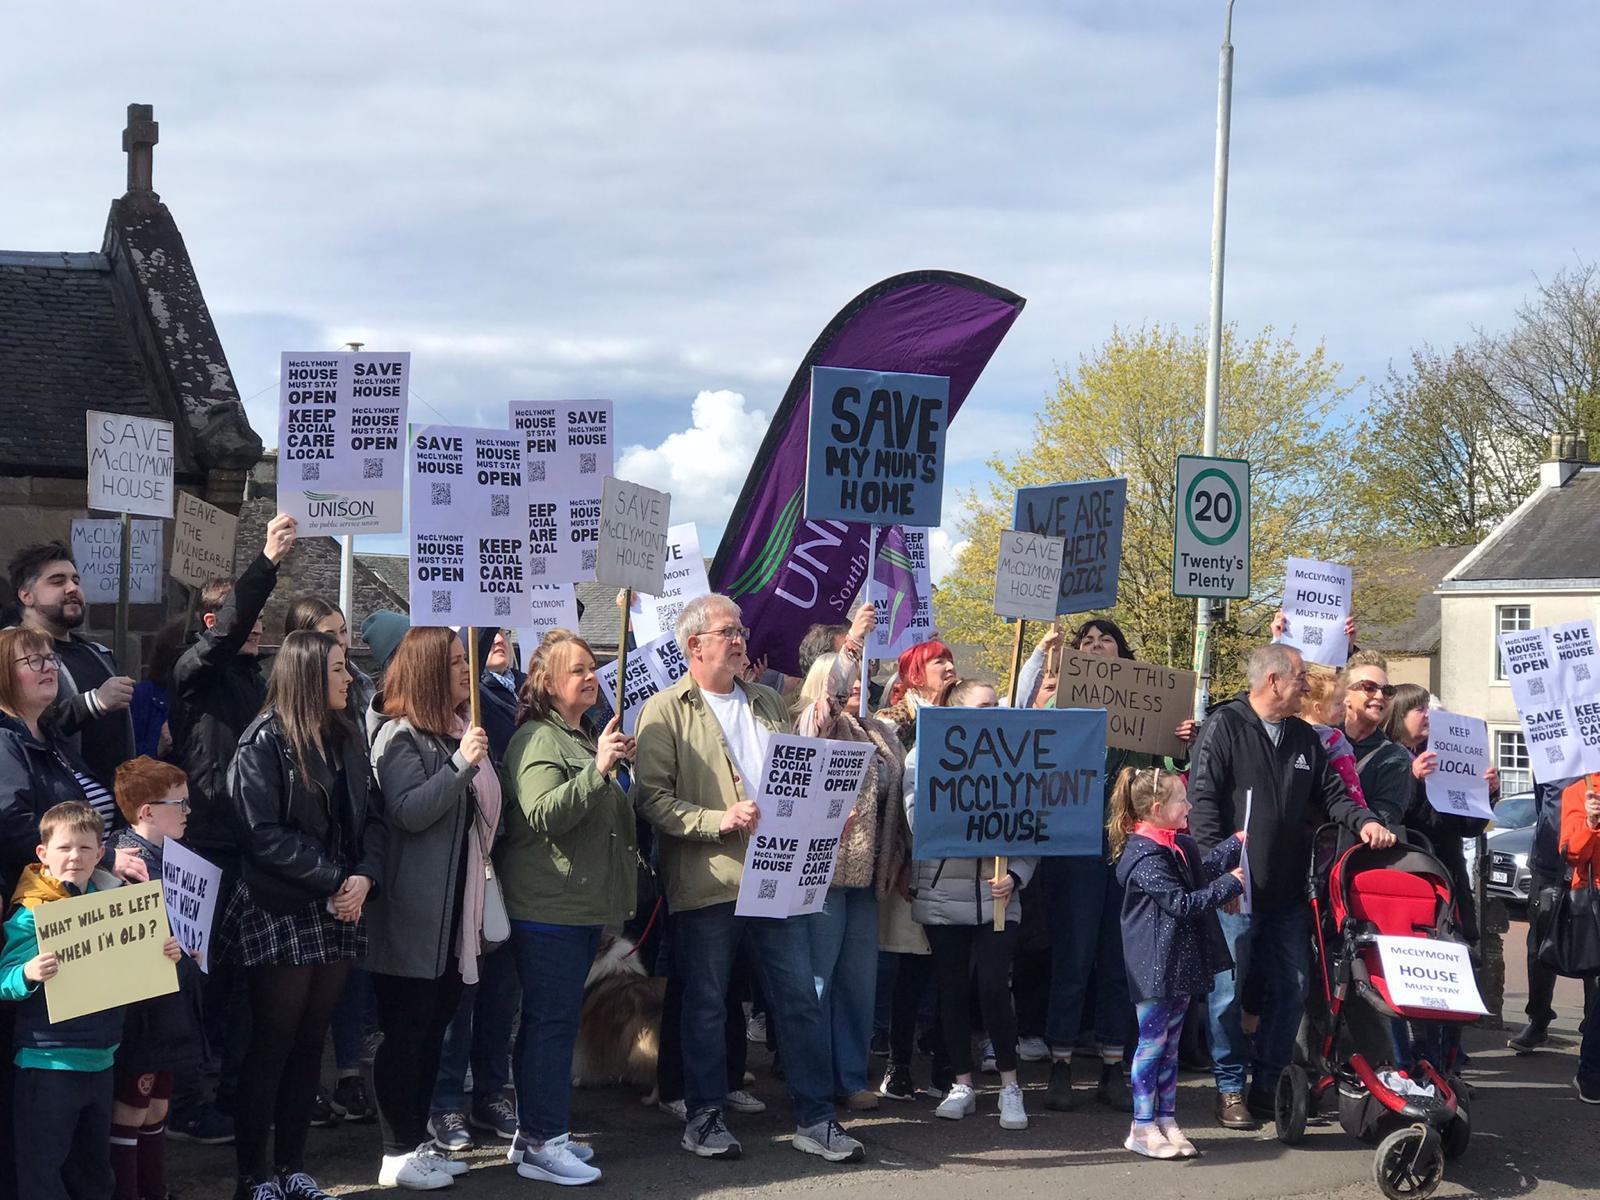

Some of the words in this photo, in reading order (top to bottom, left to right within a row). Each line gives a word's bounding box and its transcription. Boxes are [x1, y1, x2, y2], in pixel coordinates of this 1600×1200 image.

[288, 360, 338, 368] McCLYMONT
[354, 363, 402, 376] SAVE
[289, 369, 338, 380] HOUSE
[288, 381, 312, 389] MUST
[353, 386, 400, 397] HOUSE
[288, 390, 337, 404] OPEN
[288, 409, 336, 423] KEEP
[351, 416, 399, 427] HOUSE
[515, 418, 556, 429] HOUSE
[567, 411, 607, 424] SAVE
[831, 386, 942, 454] SAVE
[99, 420, 173, 452] SAVE
[288, 424, 335, 433] SOCIAL
[287, 434, 335, 448] CARE
[351, 437, 398, 450] OPEN
[416, 436, 463, 452] SAVE
[476, 439, 520, 447] McCLYMONT
[527, 439, 557, 453] PEN
[568, 434, 607, 446] HOUSE
[287, 449, 334, 461] LOCAL
[476, 448, 520, 461] HOUSE
[825, 446, 870, 478] MY
[90, 448, 174, 477] McCLYMONT
[417, 461, 463, 475] HOUSE
[476, 461, 499, 469] MUST
[500, 462, 521, 470] STAY
[477, 471, 521, 487] OPEN
[102, 475, 165, 501] HOUSE
[840, 479, 915, 516] HOME
[183, 496, 217, 525] LEAVE
[308, 500, 375, 518] UNISON
[529, 503, 557, 518] EEP
[570, 507, 601, 518] HOUS
[614, 491, 660, 527] SAVE
[1027, 497, 1070, 538] WE
[1074, 490, 1114, 530] ARE
[1194, 491, 1233, 523] 20
[182, 521, 202, 541] THE
[319, 520, 337, 530] public
[73, 527, 160, 545] McCLYONT
[417, 534, 463, 542] McCLYMONT
[529, 529, 558, 542] ARE
[571, 529, 599, 543] OPE
[602, 518, 668, 555] McCLYMONT
[91, 546, 141, 560] HOUE
[417, 543, 464, 556] HOUSE
[479, 538, 522, 554] KEEP
[1011, 537, 1062, 561] SAVE
[1063, 532, 1107, 565] HEIR
[175, 538, 231, 572] VULNERABLE
[417, 556, 440, 564] MUST
[441, 557, 464, 565] STAY
[479, 554, 522, 565] SOCIAL
[616, 546, 654, 570] HOUSE
[1181, 553, 1244, 572] Twenty's
[83, 562, 120, 575] MUST
[417, 567, 464, 582] OPEN
[480, 566, 523, 580] CARE
[1000, 559, 1062, 582] McCLYMONT
[100, 577, 142, 591] OPN
[829, 553, 867, 611] South
[1060, 565, 1105, 597] OICE
[1188, 572, 1235, 590] Plenty
[1295, 570, 1346, 586] McCLYMONT
[480, 581, 523, 594] LOCAL
[1010, 579, 1053, 600] HOUSE
[532, 600, 565, 608] CLYMONT
[1296, 590, 1342, 607] HOUSE
[533, 618, 558, 626] HOUSE
[1295, 608, 1318, 618] MUST
[1320, 610, 1339, 622] STAY
[1505, 634, 1540, 646] McCLYMONT
[1553, 628, 1590, 643] SAVE
[656, 639, 680, 659] KE
[1507, 641, 1544, 656] HOUSE
[1556, 640, 1592, 651] McCLYMONT
[662, 653, 684, 668] SOC
[1510, 653, 1527, 662] MUST
[1528, 651, 1545, 660] STAY
[1559, 646, 1595, 661] HOUSE
[668, 663, 688, 680] CA
[1068, 657, 1121, 680] STOP
[1133, 667, 1176, 690] THIS
[1512, 659, 1550, 674] OPEN
[608, 663, 649, 691] HUSE
[635, 673, 652, 686] STAY
[1072, 684, 1162, 713] MADNESS
[1525, 709, 1563, 725] SAVE
[1575, 703, 1600, 717] KEE
[1110, 715, 1145, 742] OW!
[1449, 726, 1470, 739] KEEP
[1530, 721, 1565, 732] McCLYMONT
[1531, 729, 1569, 743] HOUSE
[773, 744, 817, 761] KEEP
[939, 725, 1057, 771] SAVE
[1434, 741, 1463, 752] SOCIAL
[1464, 746, 1483, 757] CARE
[771, 759, 813, 772] SOCIAL
[830, 757, 864, 769] HOUSE
[1439, 760, 1477, 776] LOCAL
[769, 770, 812, 786] CARE
[824, 779, 857, 792] OPEN
[765, 784, 808, 798] LOCAL
[929, 769, 1097, 812] MCCLYMONT
[966, 809, 1053, 845] HOUSE
[756, 836, 799, 852] SAVE
[809, 838, 838, 852] KEEP
[754, 851, 795, 860] McCLYMONT
[806, 851, 833, 862] SOCIAL
[752, 859, 793, 872] HOUSE
[802, 861, 831, 875] CARE
[164, 860, 181, 885] WHAT
[181, 870, 197, 893] WILL
[197, 877, 208, 899] BE
[798, 875, 827, 886] LOCAL
[179, 893, 200, 922] WHEN
[38, 918, 72, 940] WHAT
[78, 908, 104, 927] WILL
[109, 903, 124, 918] BE
[129, 892, 160, 913] LEFT
[55, 939, 91, 965] WHEN
[97, 931, 114, 952] I'M
[1390, 946, 1460, 962] McCLYMONT
[1400, 965, 1459, 983] HOUSE
[1405, 982, 1433, 992] MUST
[1436, 986, 1460, 994] STAY
